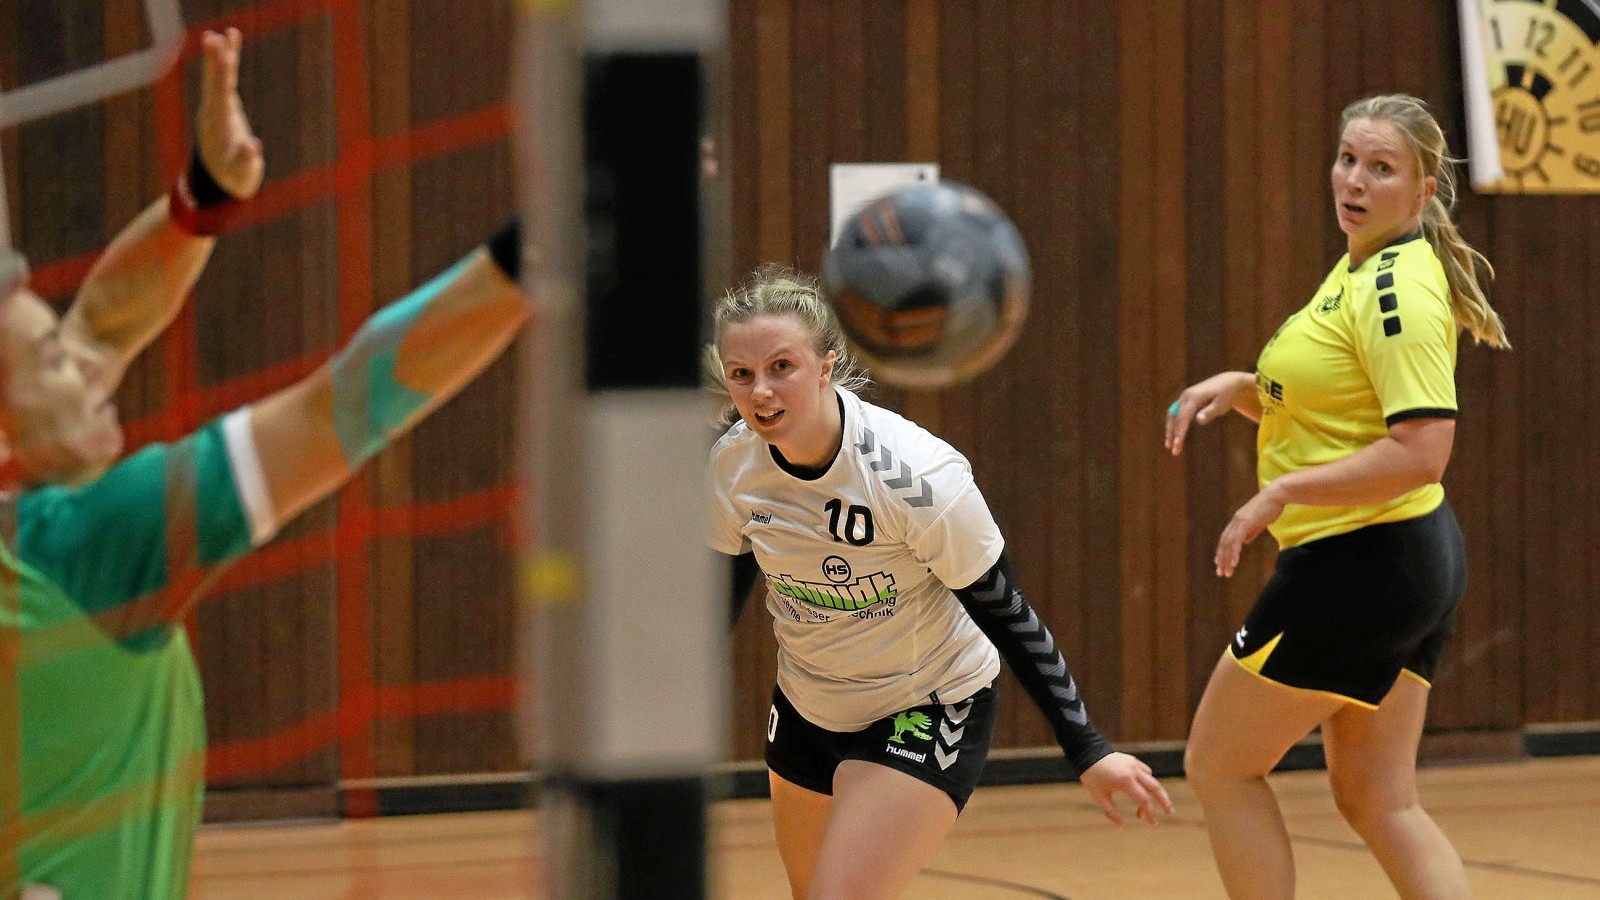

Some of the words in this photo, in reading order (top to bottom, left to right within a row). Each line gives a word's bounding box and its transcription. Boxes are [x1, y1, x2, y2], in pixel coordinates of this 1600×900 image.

[1523, 16, 1556, 59] 12
[1557, 46, 1594, 90] 11
[1495, 100, 1539, 157] HU
[823, 497, 875, 547] 10
[766, 571, 898, 612] chmidt
[825, 564, 849, 576] HS
[886, 743, 927, 764] hummel
